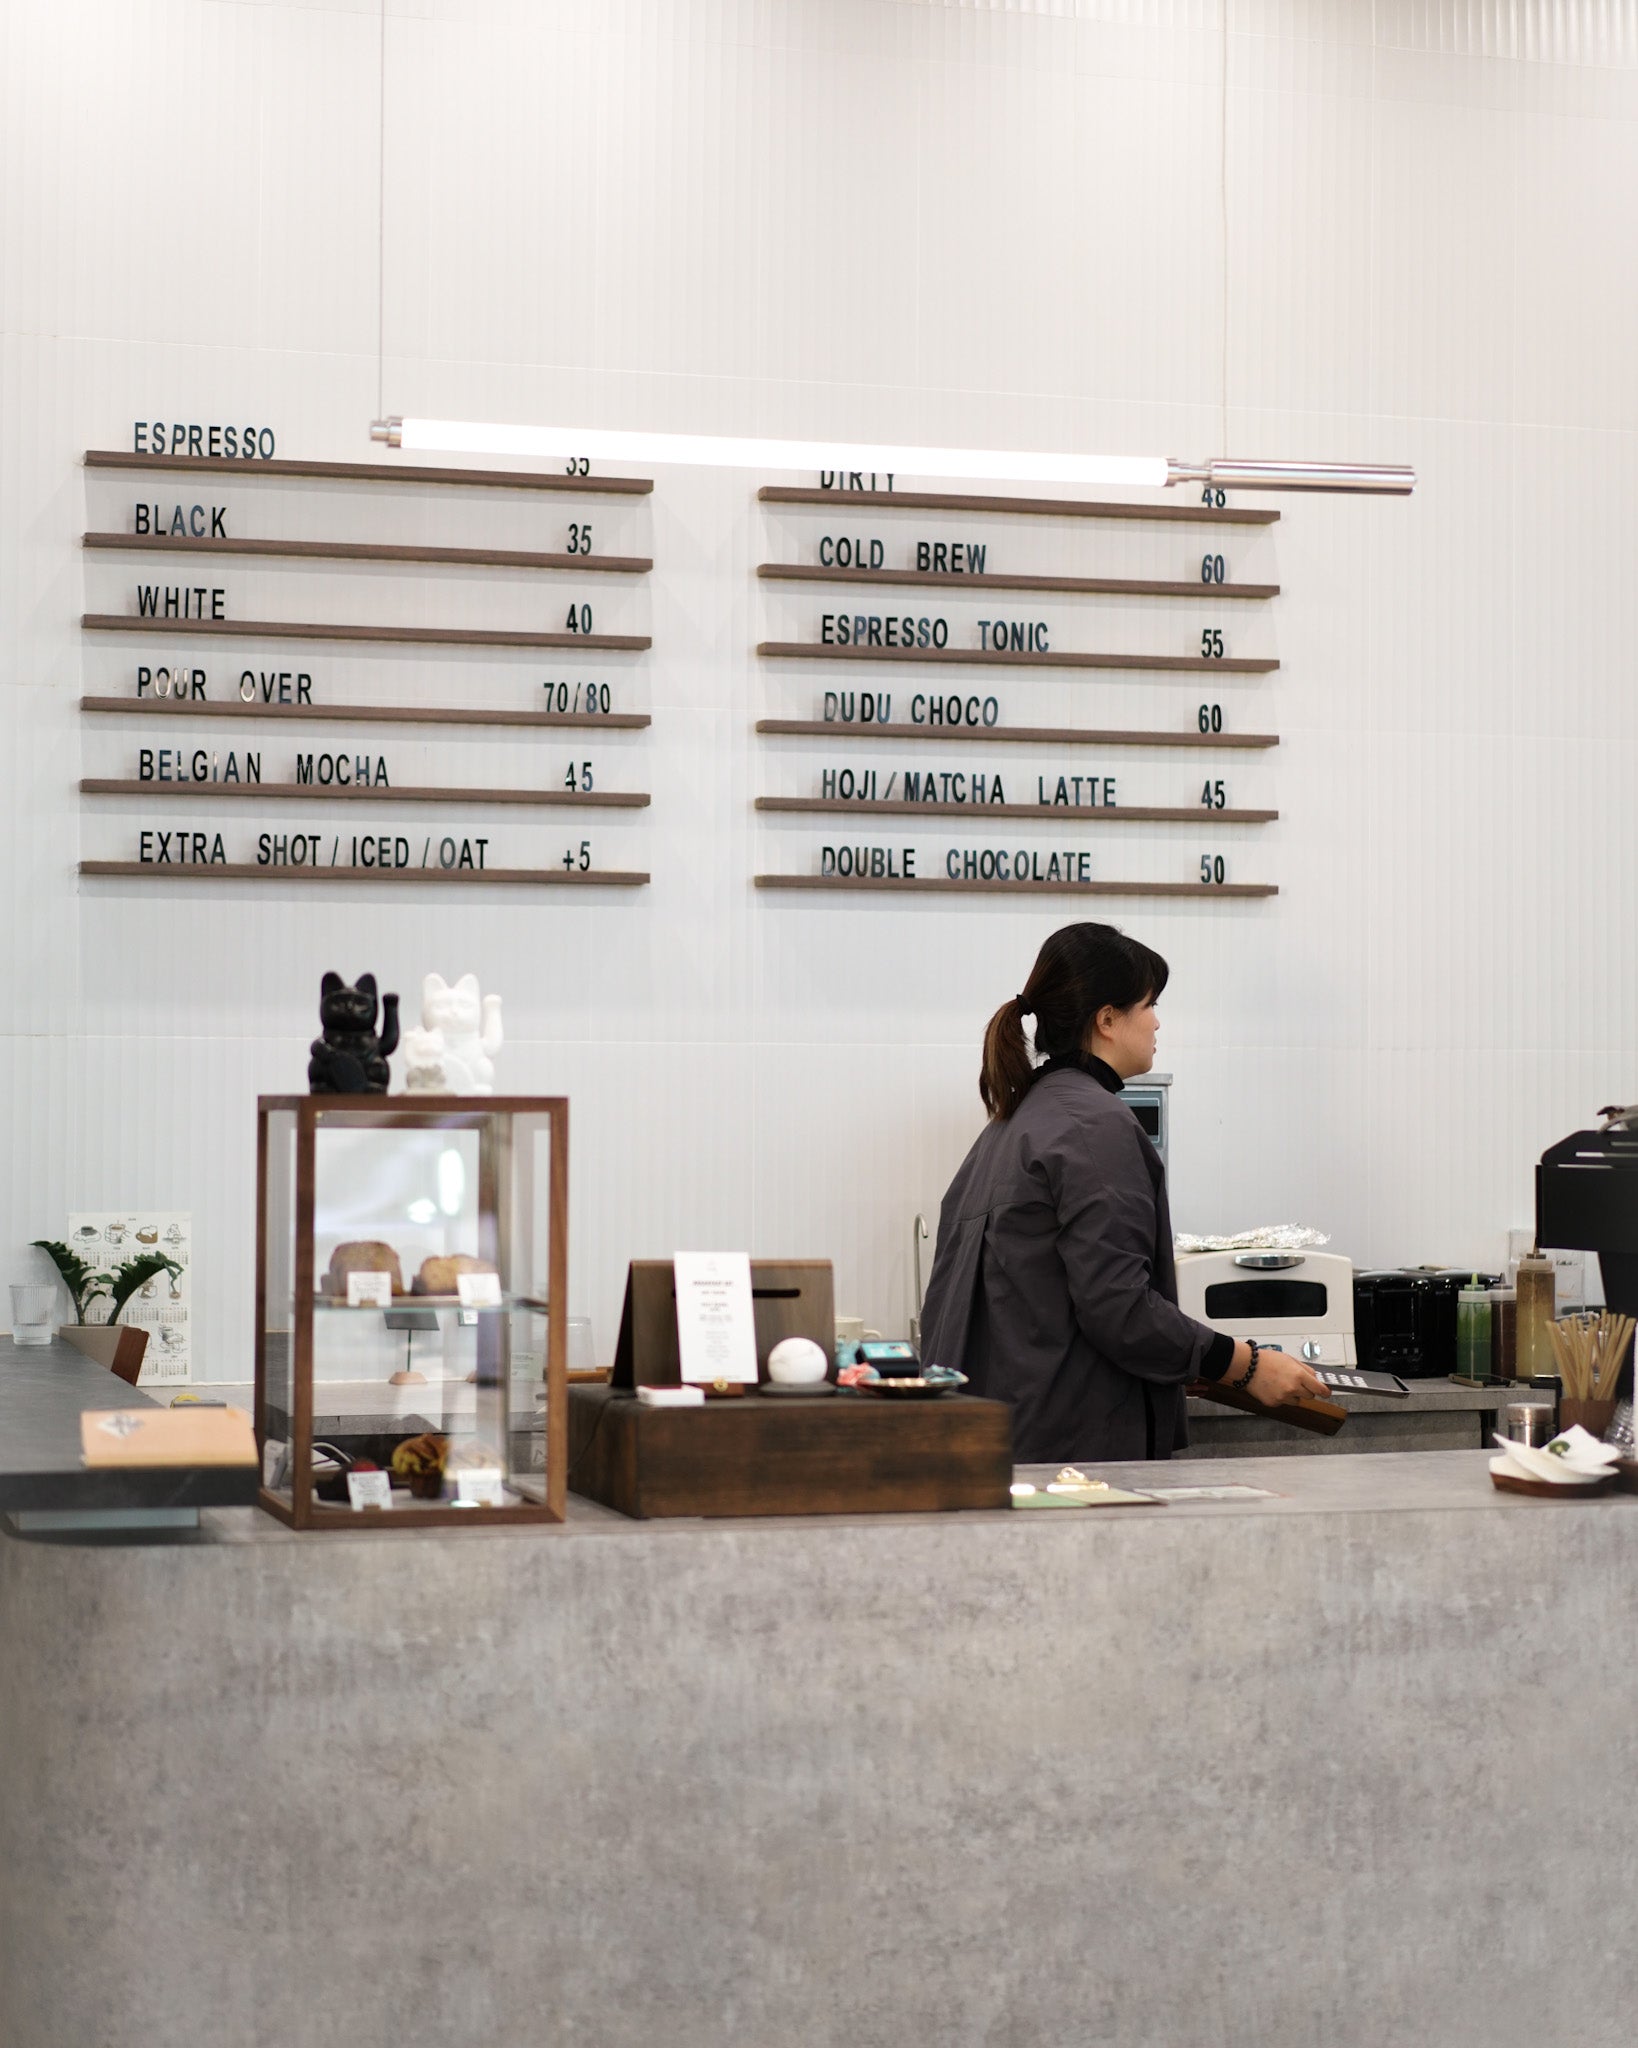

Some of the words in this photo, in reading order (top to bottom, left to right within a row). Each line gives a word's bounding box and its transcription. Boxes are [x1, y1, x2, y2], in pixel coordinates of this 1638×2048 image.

[134, 422, 275, 460] ESPRESSO
[1201, 487, 1226, 509] 48
[135, 504, 227, 538] BLACK
[567, 523, 592, 556] 35
[819, 536, 884, 569] COLD
[916, 542, 986, 574] BREW
[1201, 554, 1225, 584] 60
[138, 585, 226, 619] WHITE
[566, 604, 593, 635] 40
[821, 614, 949, 648] ESPRESSO
[977, 620, 1050, 652] TONIC
[1201, 629, 1224, 658] 55
[137, 667, 207, 700] POUR
[239, 670, 312, 704] OVER
[543, 682, 611, 714] 70/80
[824, 691, 891, 725] DUDU
[911, 694, 999, 728] CHOCO
[1198, 704, 1222, 734] 60
[138, 749, 261, 783] BELGIAN
[296, 753, 389, 787] MOCHA
[564, 762, 594, 792] 45
[1039, 776, 1116, 807] LATTE
[1201, 780, 1226, 810] 45
[139, 831, 227, 864] EXTRA
[562, 841, 591, 873] +5
[821, 846, 916, 879] DOUBLE
[946, 849, 1091, 883] CHOCOLATE
[1200, 855, 1226, 885] 50
